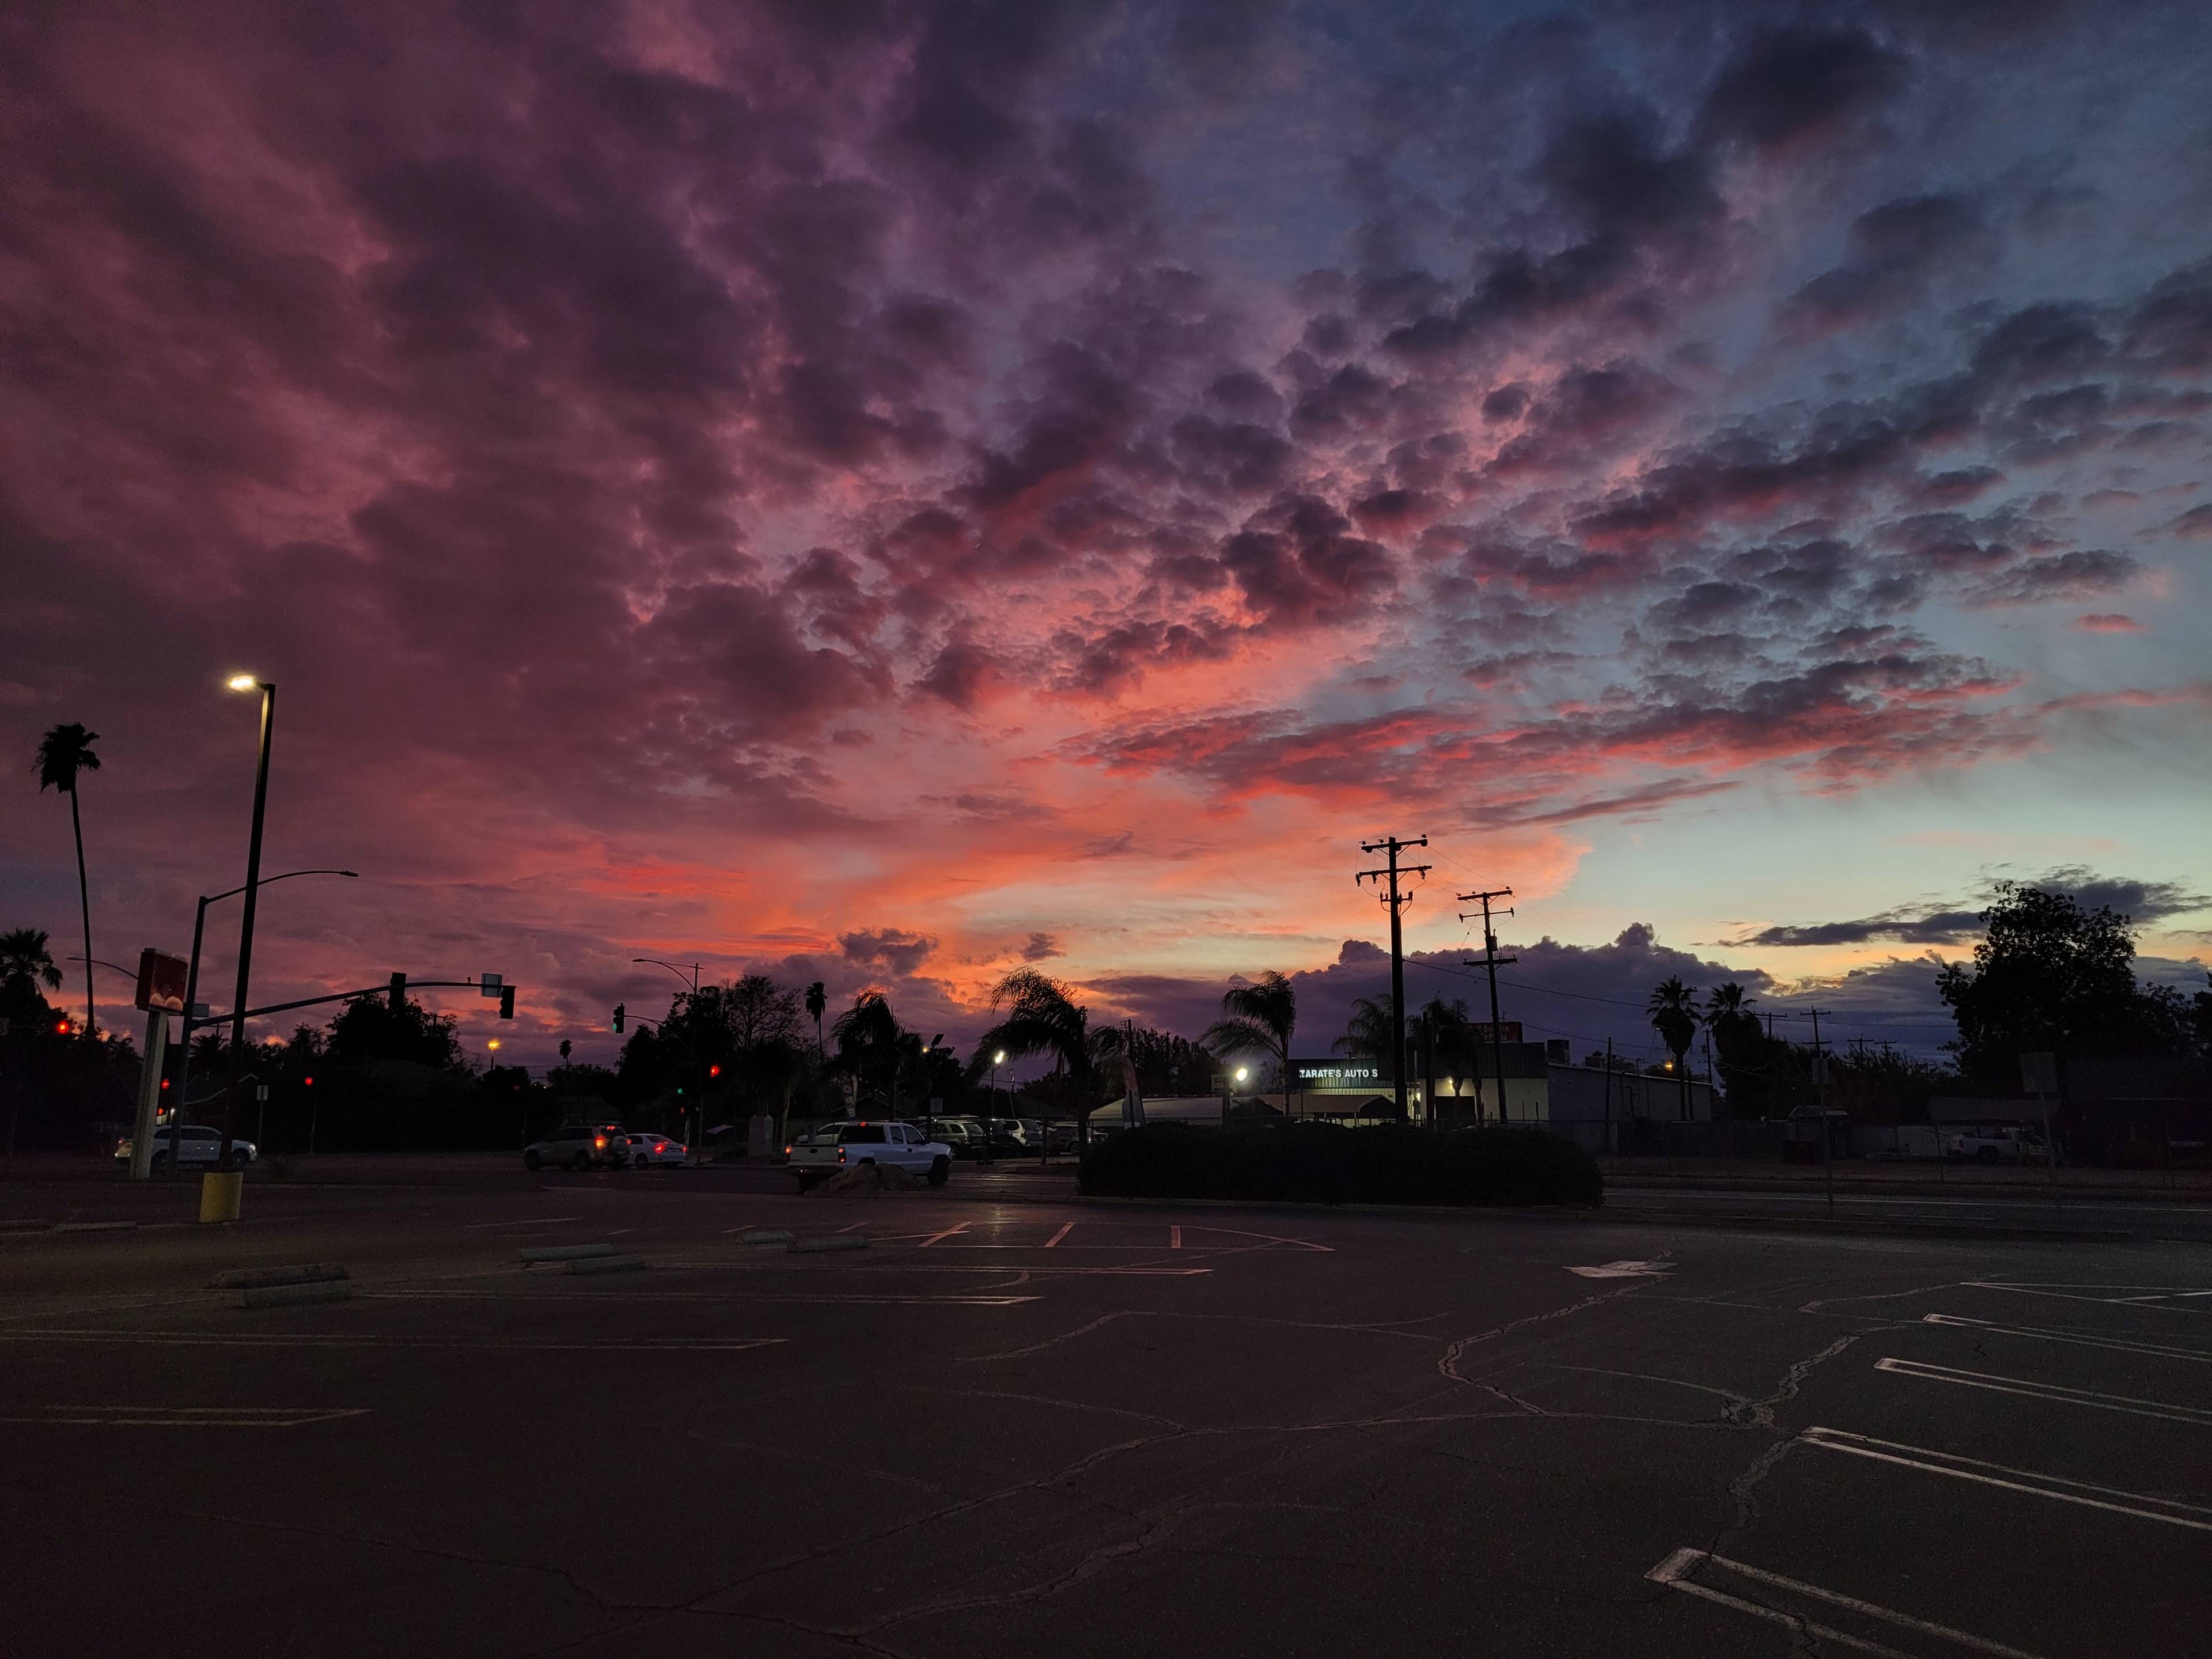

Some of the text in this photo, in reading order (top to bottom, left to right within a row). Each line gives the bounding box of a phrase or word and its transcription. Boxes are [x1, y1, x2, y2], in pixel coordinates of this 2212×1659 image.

[1483, 1024, 1510, 1032] Seice
[1299, 1069, 1342, 1078] ZARATE'S
[1344, 1069, 1369, 1078] AUTO
